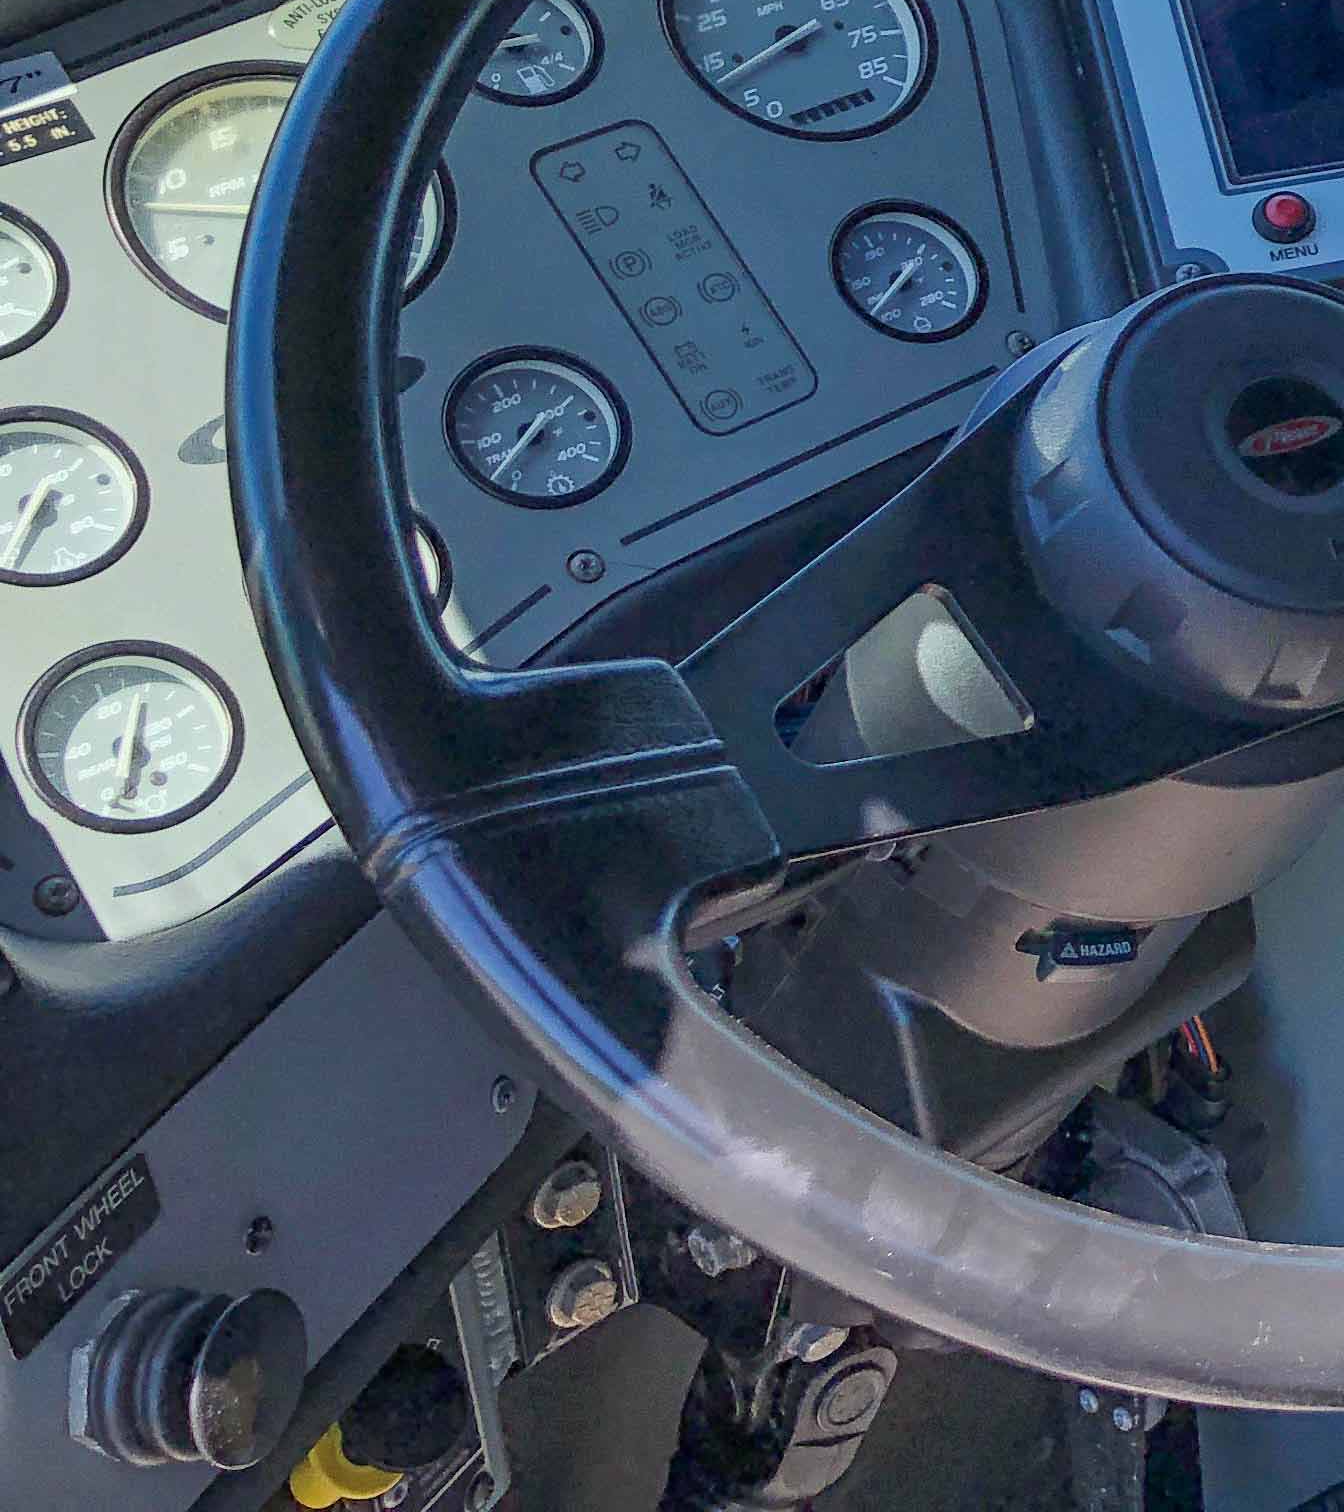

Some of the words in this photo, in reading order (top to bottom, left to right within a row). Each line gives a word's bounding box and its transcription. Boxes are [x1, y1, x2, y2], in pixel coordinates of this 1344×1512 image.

[756, 0, 784, 16] MPH
[697, 9, 727, 32] 25
[848, 25, 878, 48] 75
[703, 51, 725, 72] 15
[858, 56, 889, 79] 85
[743, 88, 760, 107] 5
[766, 100, 783, 118] 0
[1269, 243, 1320, 262] MENU
[492, 393, 521, 413] 200
[477, 433, 502, 450] 100
[557, 443, 586, 461] 400
[512, 470, 522, 481] 0
[1079, 941, 1131, 956] HAZARD
[3, 1234, 69, 1316] FRONT
[73, 1167, 145, 1240] WHEEL
[57, 1237, 113, 1303] LOCK
